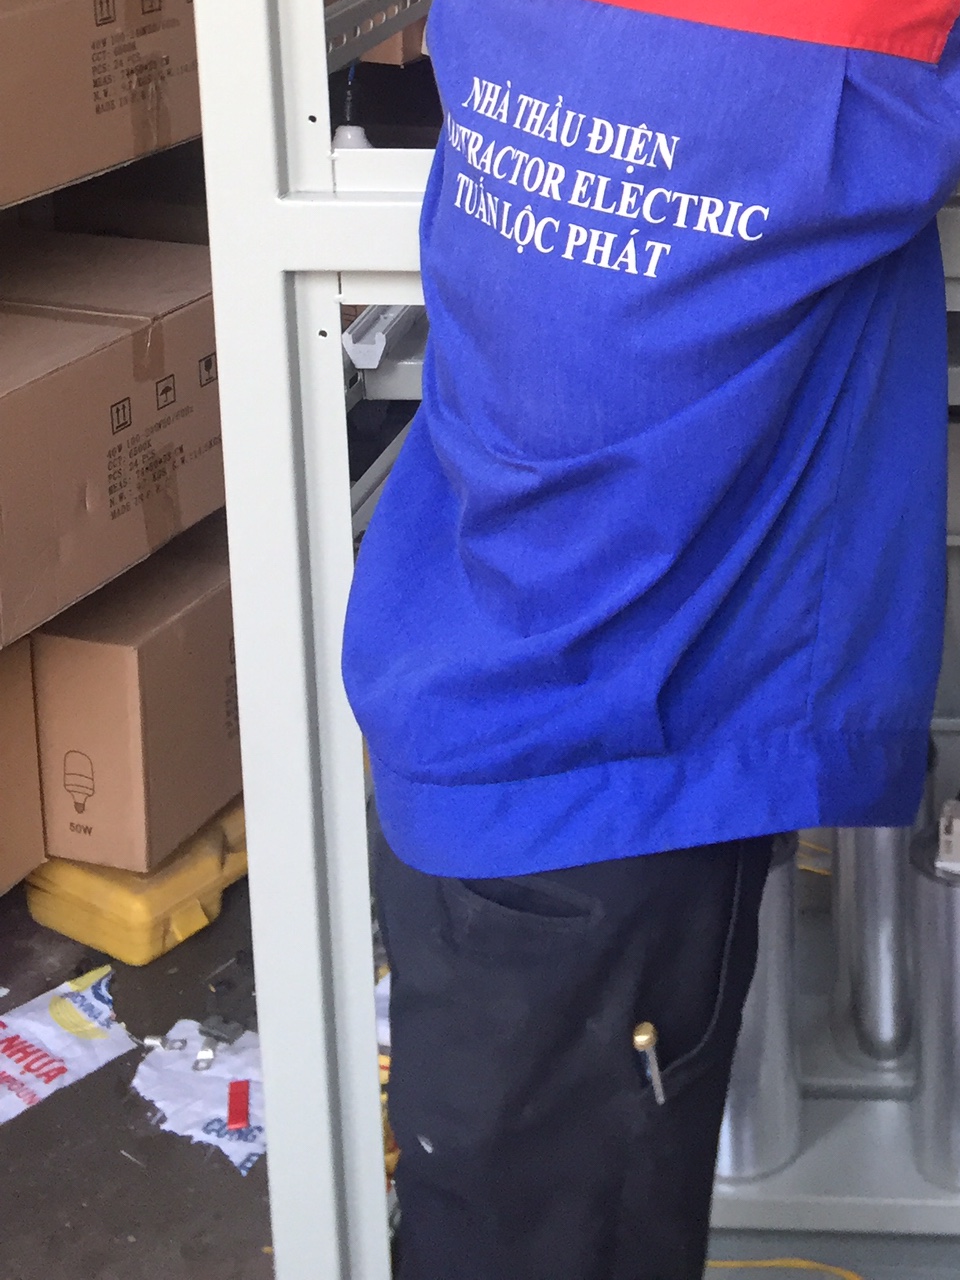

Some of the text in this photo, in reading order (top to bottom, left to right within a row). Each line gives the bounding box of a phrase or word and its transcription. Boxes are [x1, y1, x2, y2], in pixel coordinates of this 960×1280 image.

[461, 76, 681, 174] NHÀ THẦU ĐIỆN
[454, 173, 671, 278] TUẤN LỘC PHÁT
[567, 169, 770, 241] ELECTRIC
[69, 822, 93, 836] 50W
